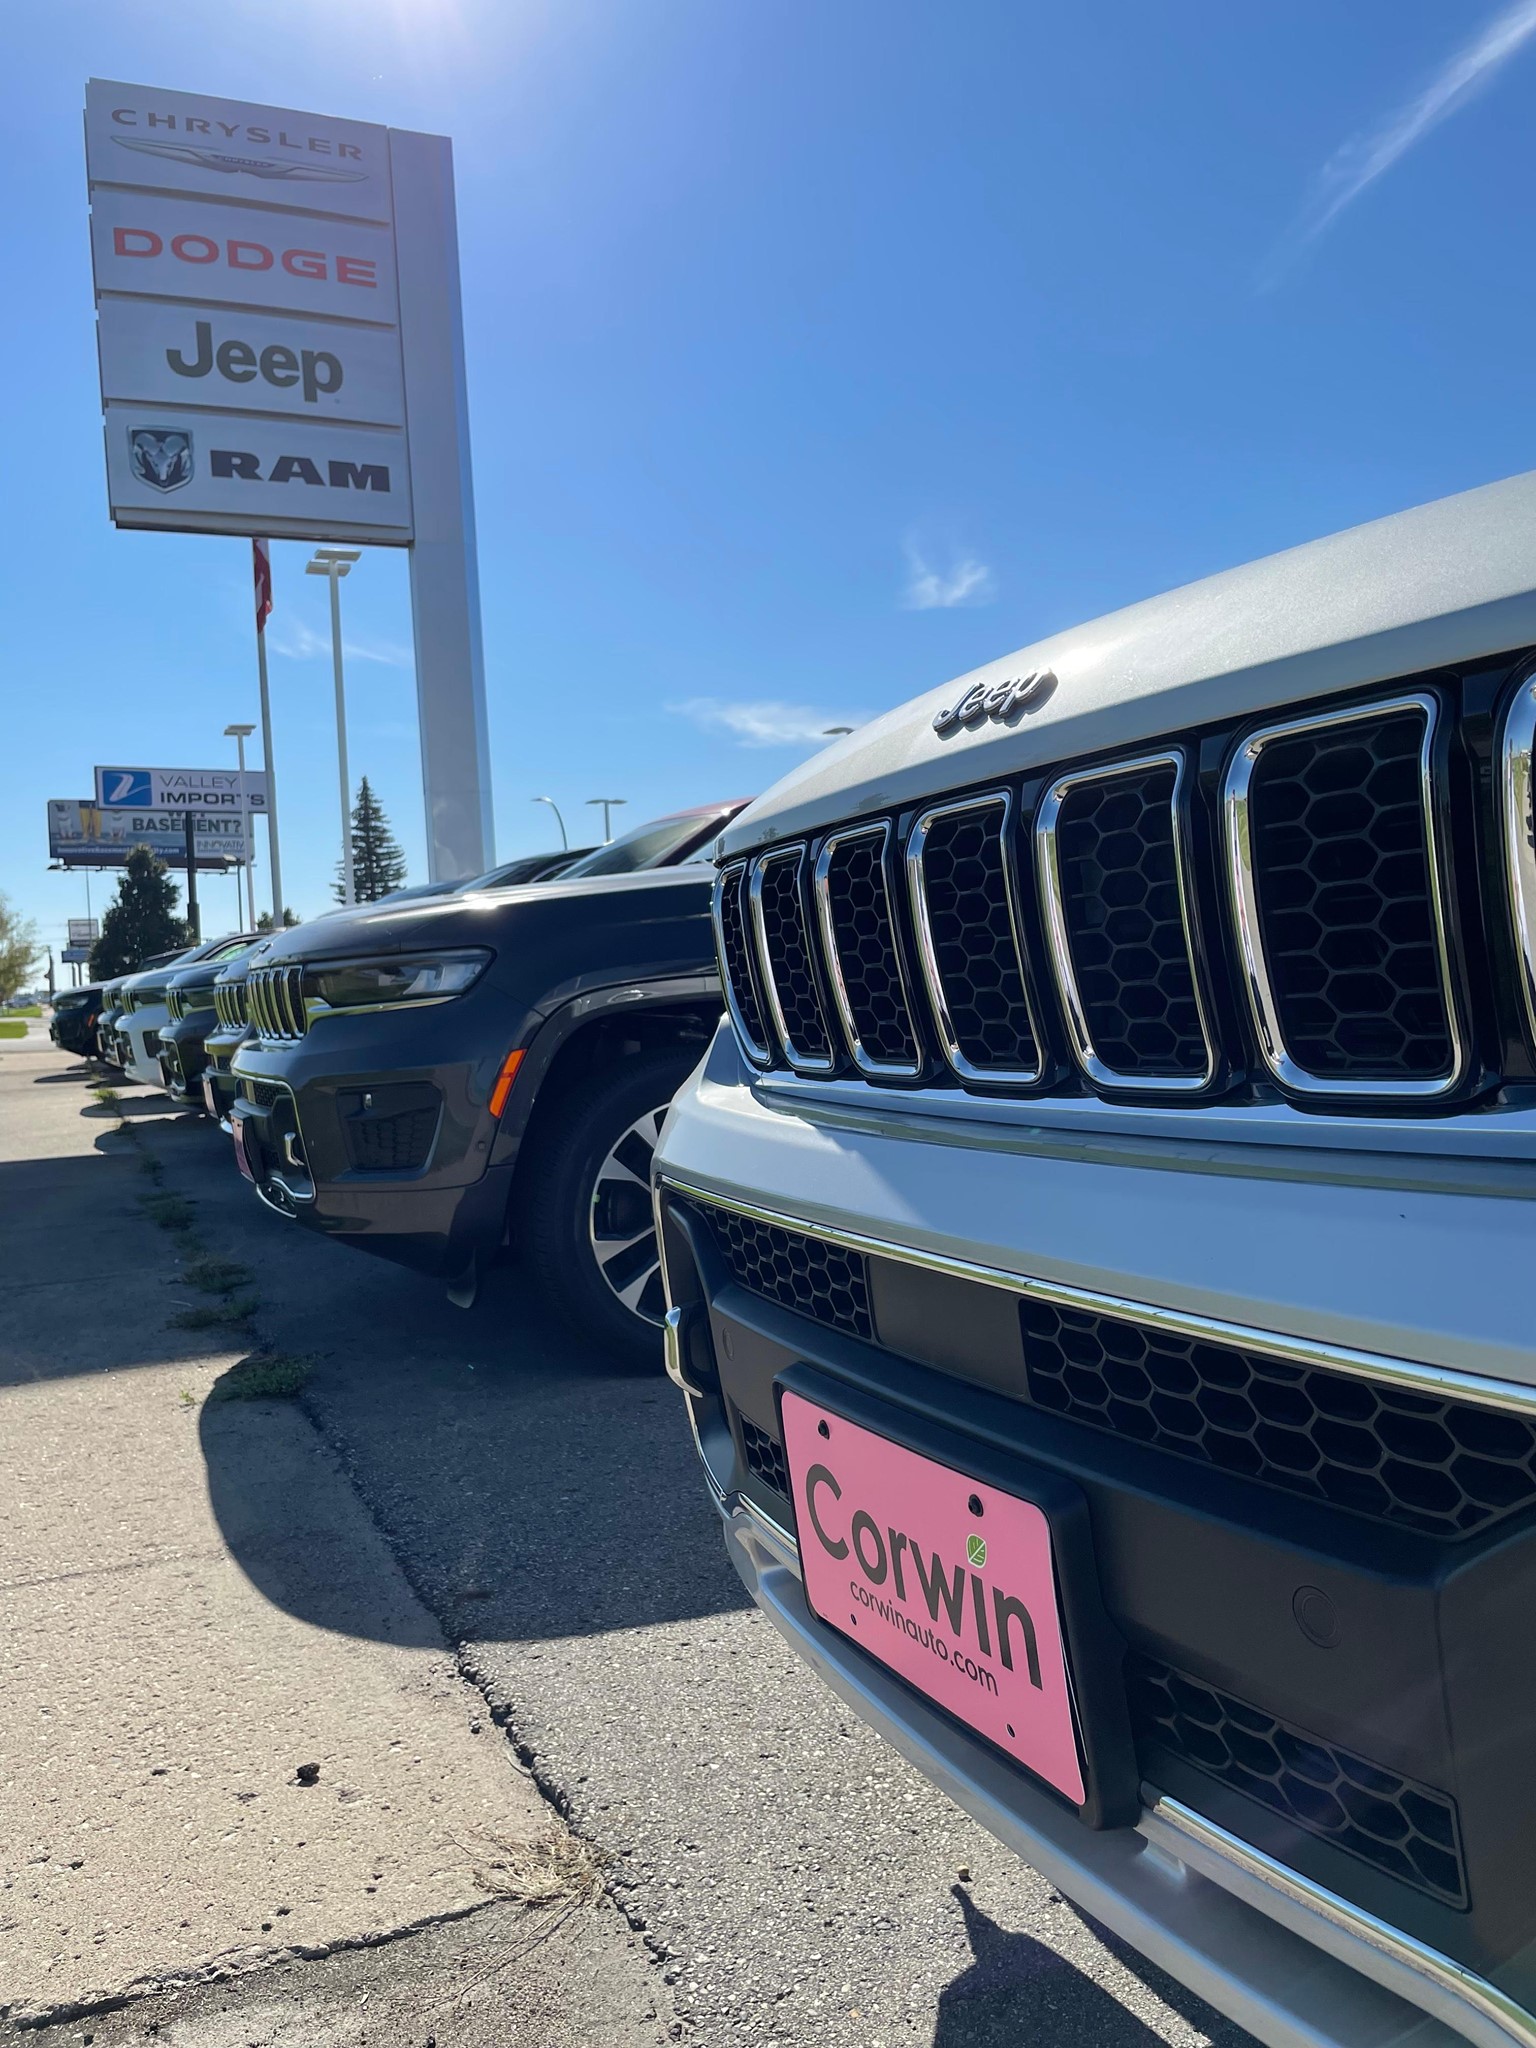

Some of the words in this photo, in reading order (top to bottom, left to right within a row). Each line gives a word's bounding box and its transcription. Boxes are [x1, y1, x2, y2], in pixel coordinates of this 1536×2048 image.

[111, 108, 363, 161] CHRYSLER
[113, 227, 378, 289] DODGE
[166, 321, 343, 403] Jeep
[210, 449, 391, 493] RAM
[932, 667, 1051, 733] Jeep
[160, 775, 237, 789] VALLEY
[196, 839, 247, 850] INNOVATIV
[805, 1463, 1043, 1691] Corwin
[849, 1580, 999, 1697] corwinauto.com
